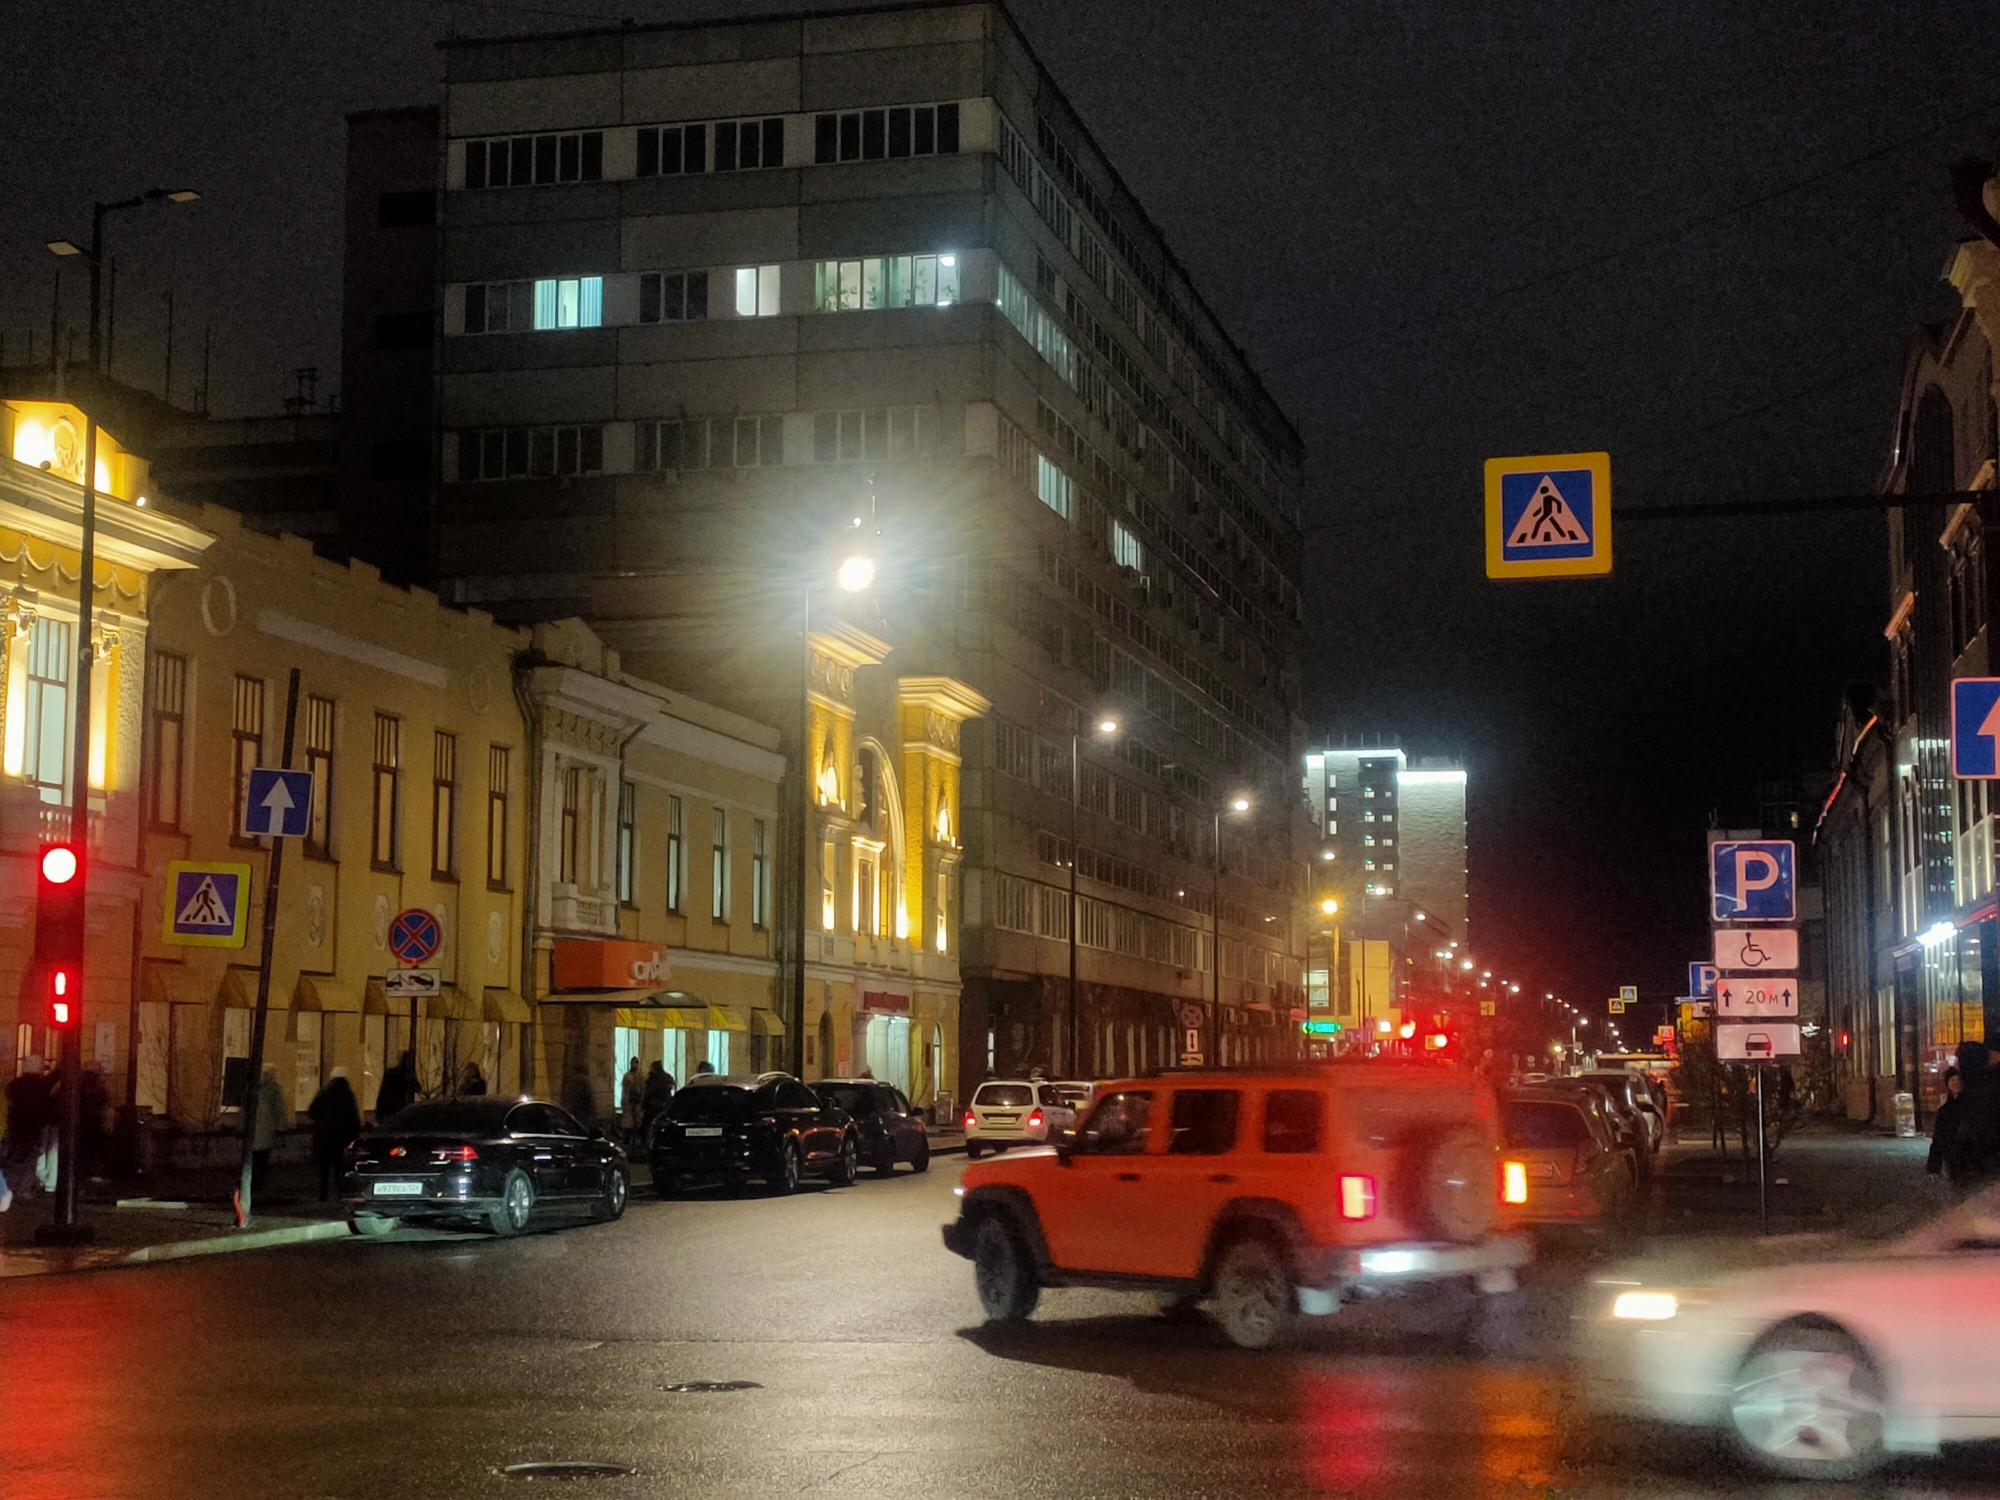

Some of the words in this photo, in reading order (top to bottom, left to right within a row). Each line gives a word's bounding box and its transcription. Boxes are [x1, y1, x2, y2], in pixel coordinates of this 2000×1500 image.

[1735, 850, 1779, 911] P
[1700, 966, 1720, 994] P
[1745, 990, 1766, 1005] 20
